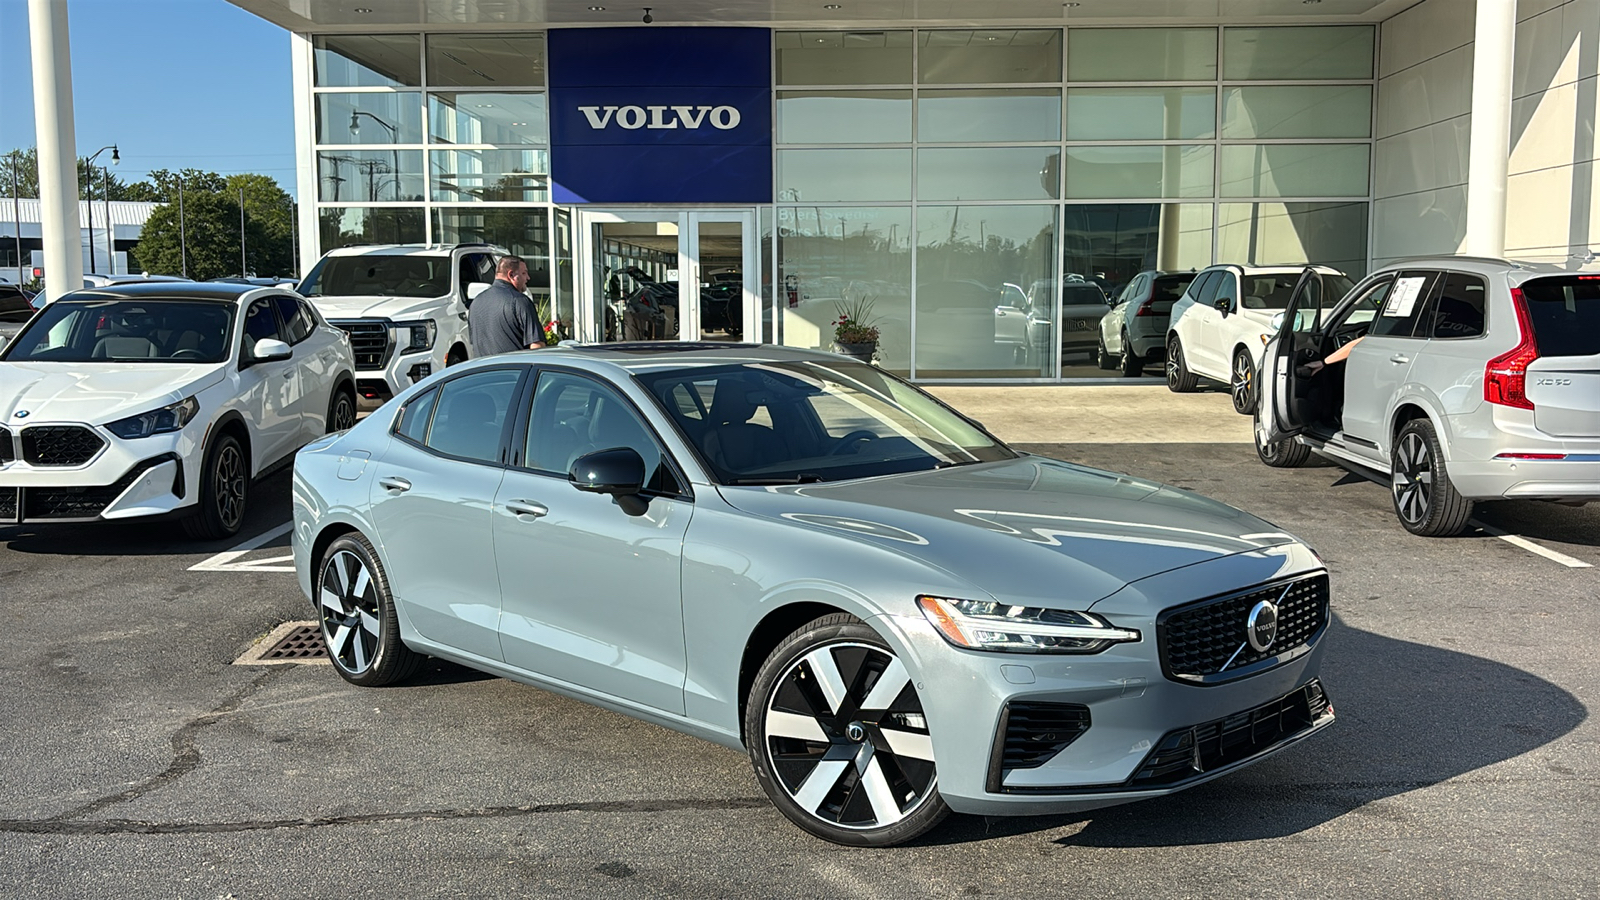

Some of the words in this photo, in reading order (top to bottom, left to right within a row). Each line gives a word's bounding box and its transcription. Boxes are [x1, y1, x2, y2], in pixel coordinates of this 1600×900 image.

[578, 106, 741, 130] VOLVO
[779, 208, 818, 223] Byers
[779, 225, 812, 238] Cars
